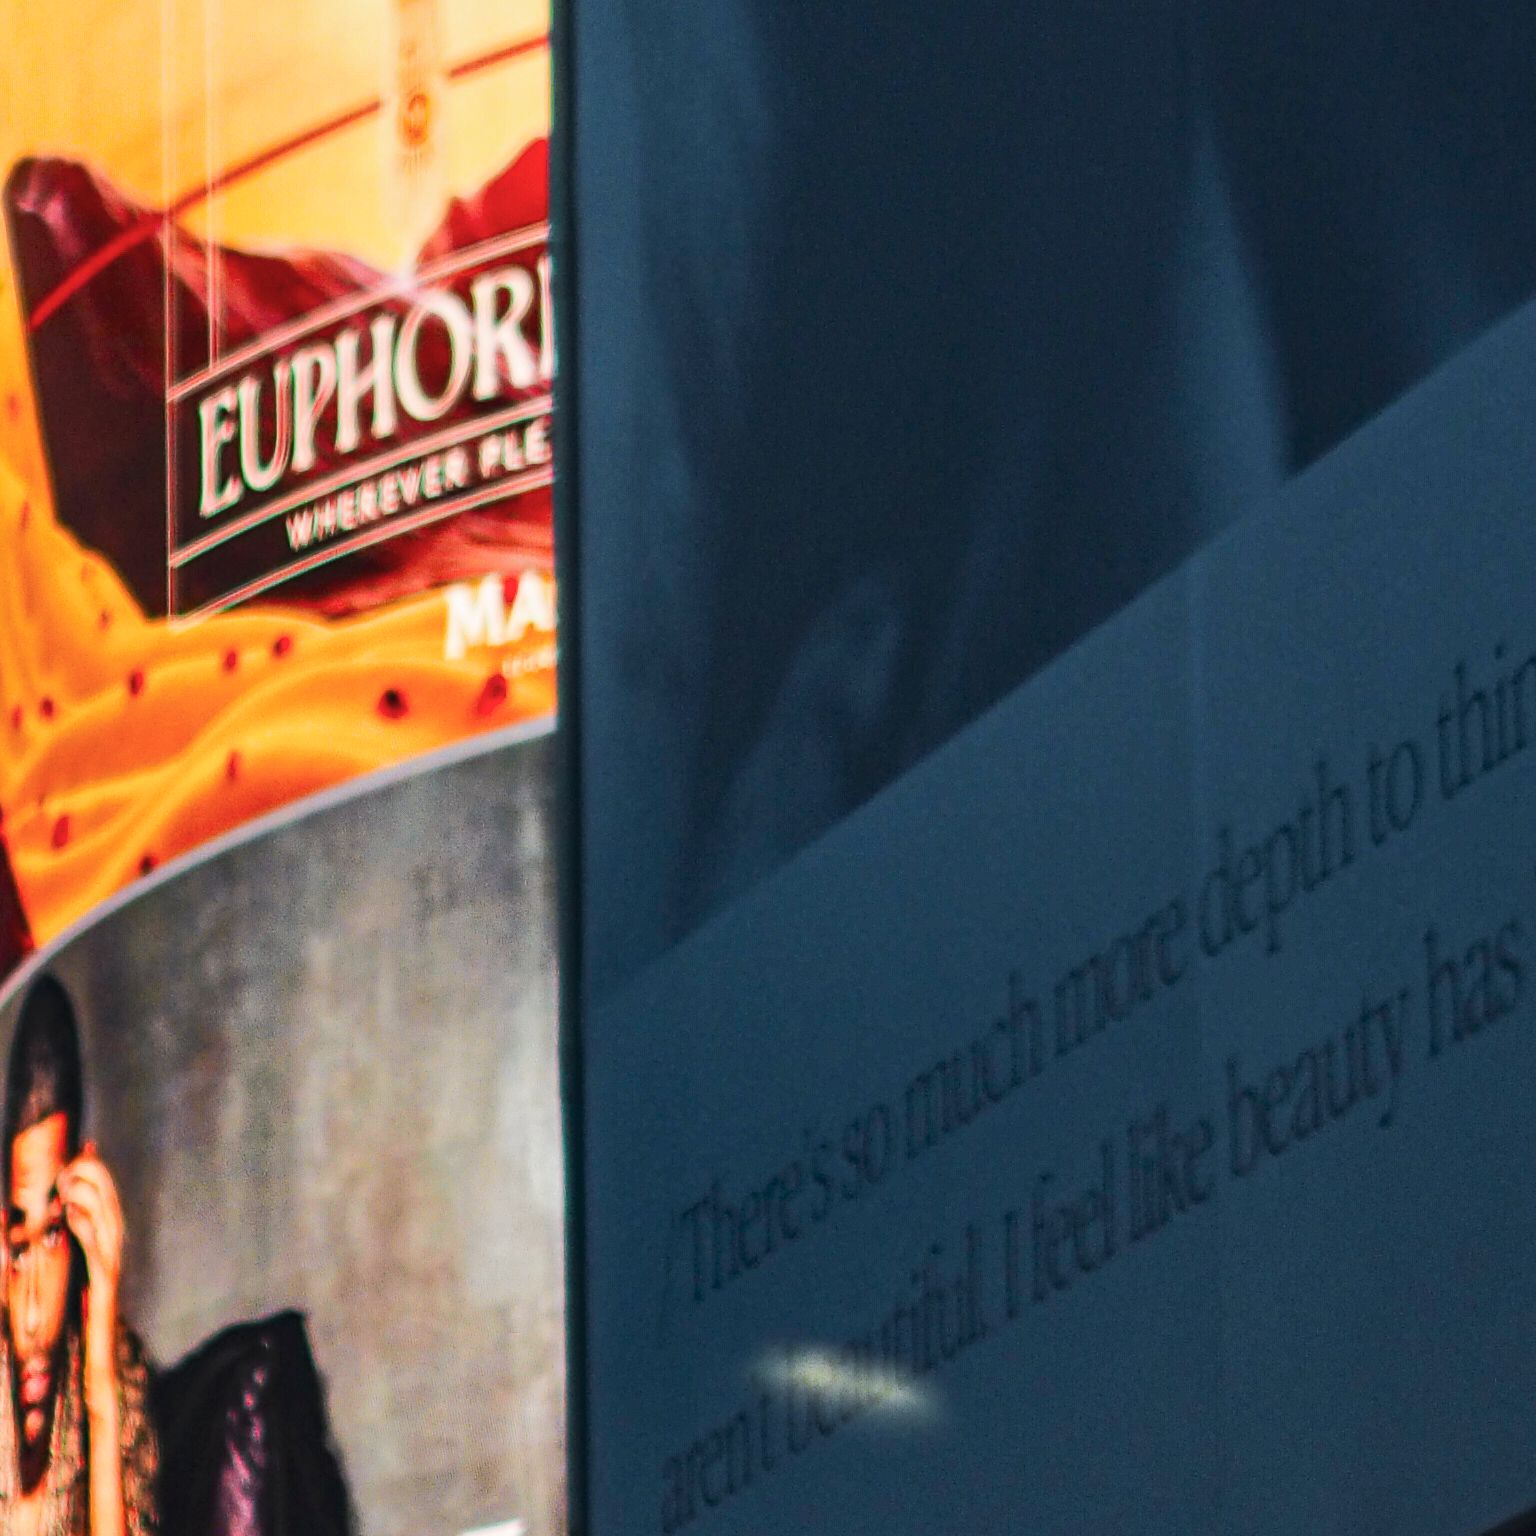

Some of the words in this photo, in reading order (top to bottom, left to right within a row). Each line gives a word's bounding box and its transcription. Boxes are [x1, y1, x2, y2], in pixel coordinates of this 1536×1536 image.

[285, 446, 469, 551] WHEREVER
[444, 569, 556, 660] MA
[677, 1125, 835, 1302] There's
[841, 1103, 894, 1201] so
[904, 966, 1046, 1160] much
[1054, 897, 1189, 1058] more
[1197, 750, 1356, 958] depth
[1366, 739, 1425, 846] to
[1002, 1209, 1020, 1322] I
[1030, 1139, 1125, 1303] feel
[1127, 1102, 1216, 1243] like
[1225, 985, 1412, 1178] beauty
[1424, 918, 1526, 1061] has
